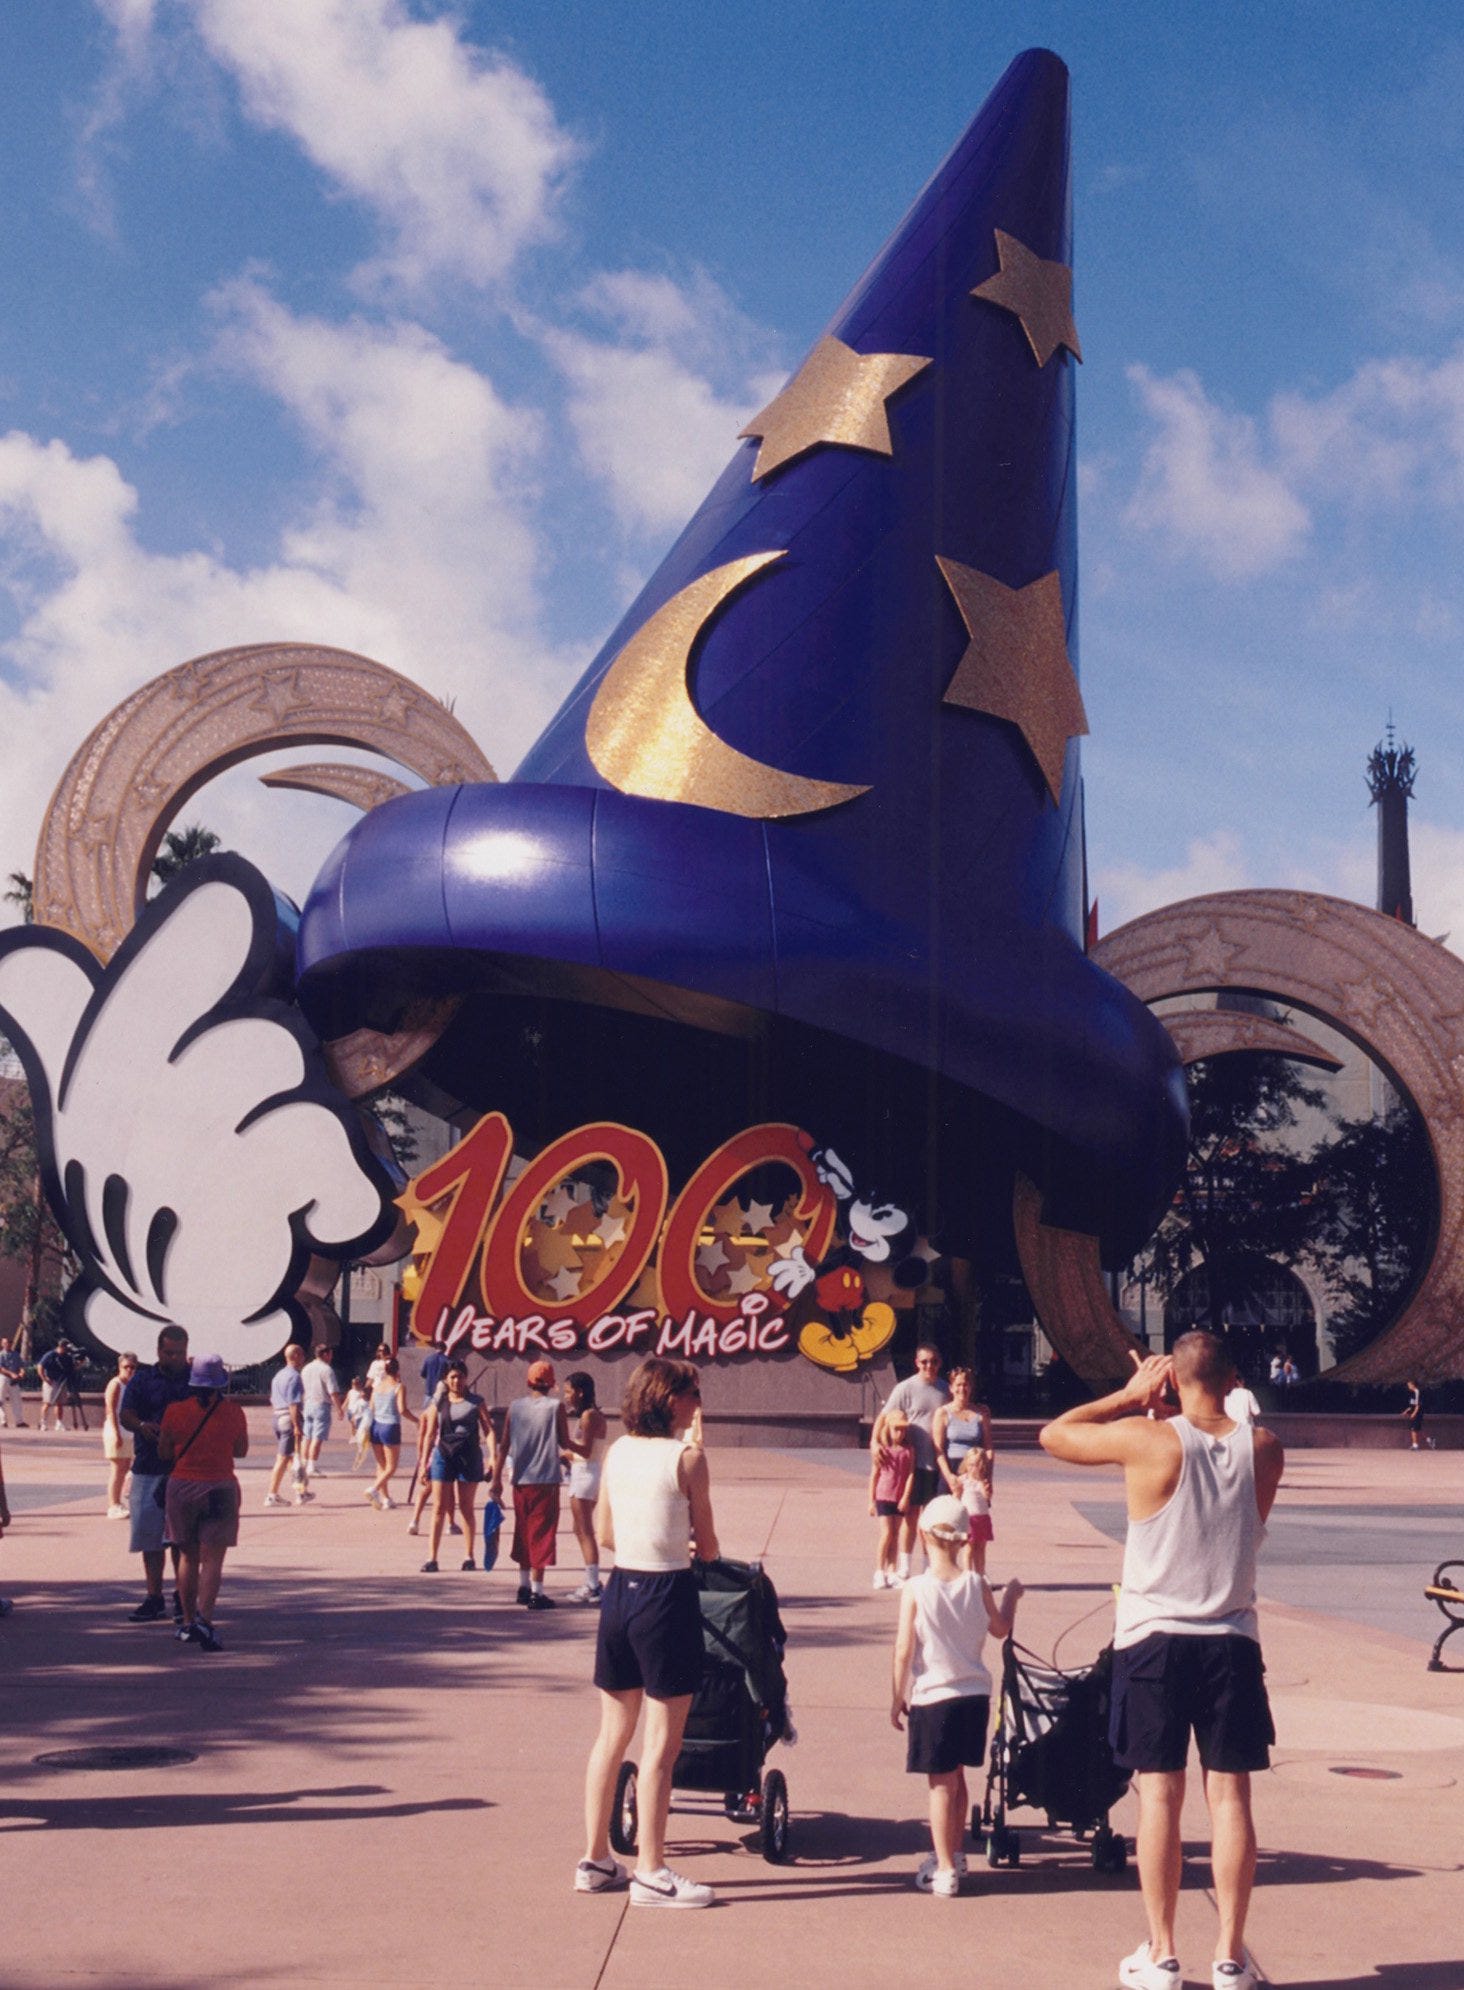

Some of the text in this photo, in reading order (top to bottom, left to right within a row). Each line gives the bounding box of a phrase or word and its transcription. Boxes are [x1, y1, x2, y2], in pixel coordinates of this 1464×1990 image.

[411, 1111, 837, 1342] 100
[434, 1293, 790, 1356] YEARS OF MAGIC
